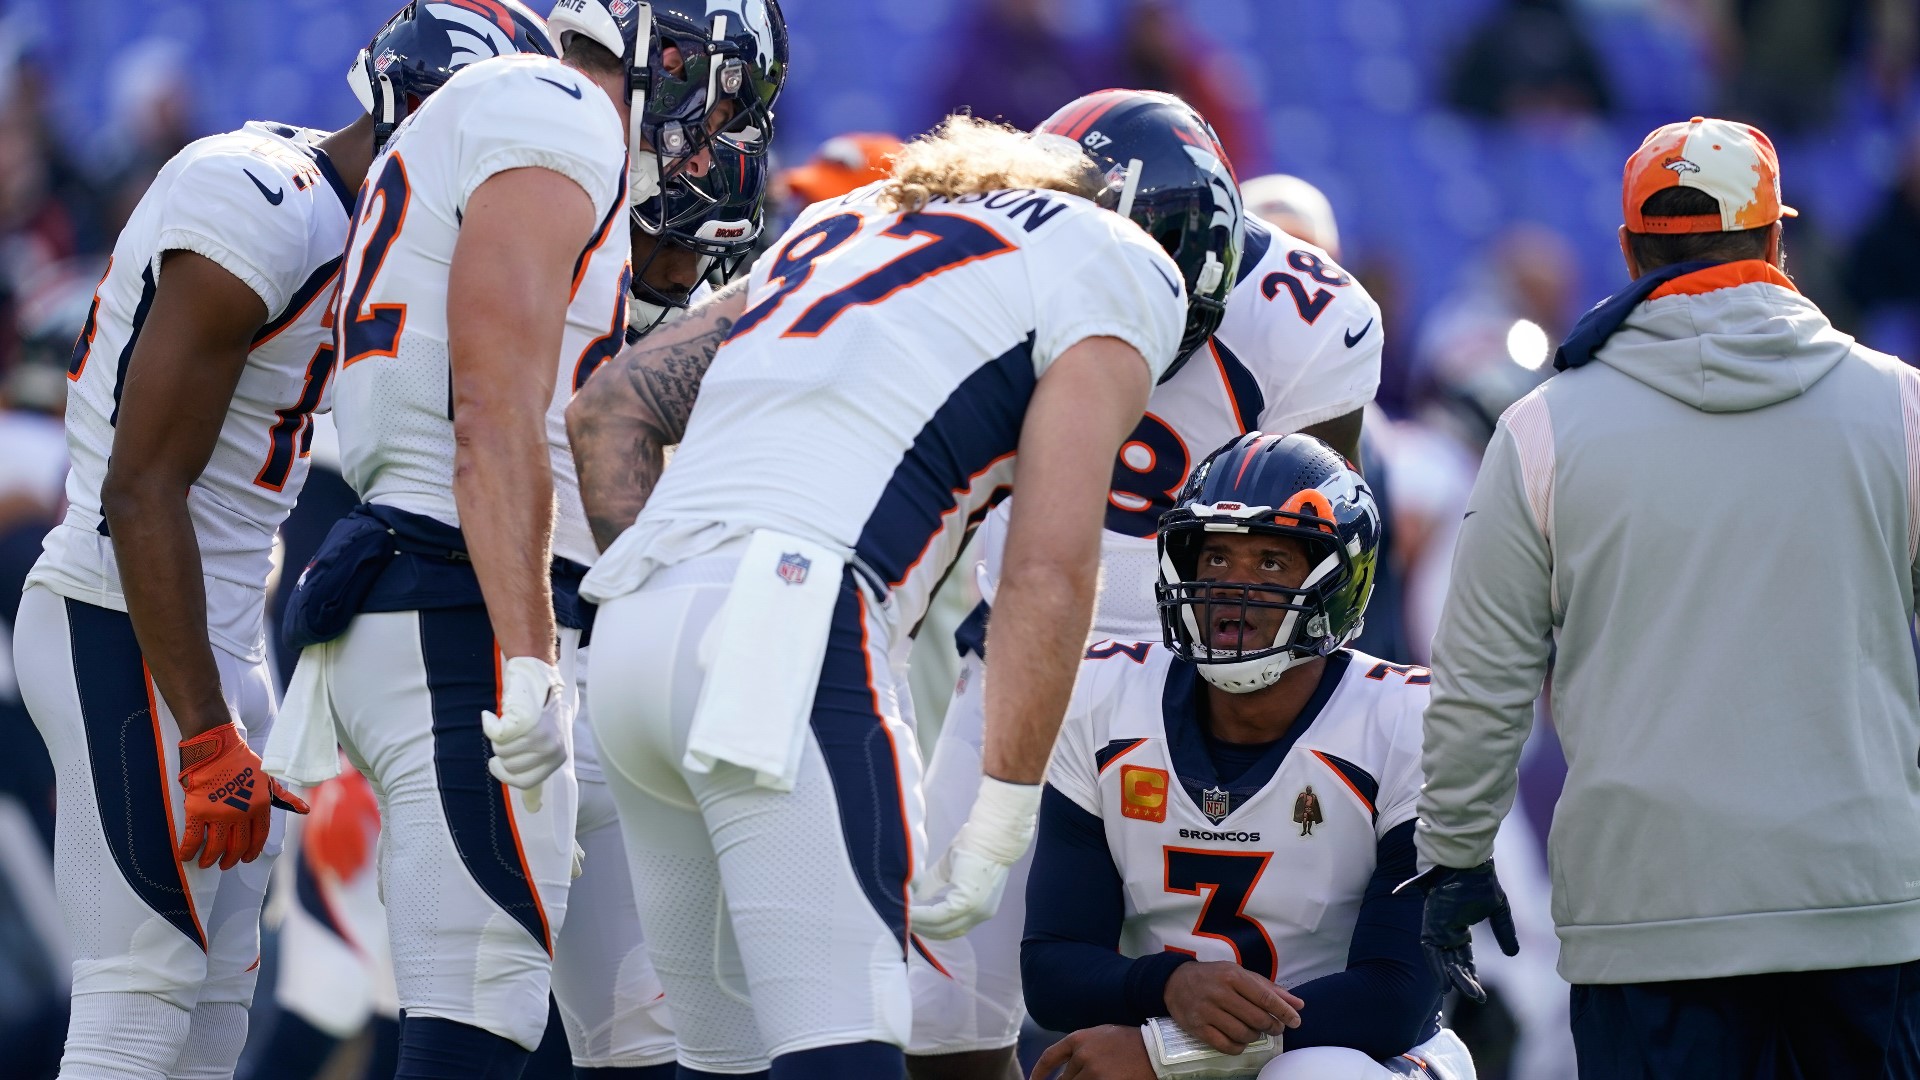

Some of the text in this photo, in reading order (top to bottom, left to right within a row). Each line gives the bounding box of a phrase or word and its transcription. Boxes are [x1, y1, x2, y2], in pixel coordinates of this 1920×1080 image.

[611, 2, 625, 15] NFL
[1084, 131, 1113, 149] 87
[715, 228, 745, 238] BRONCOS
[719, 211, 1021, 347] 87
[1260, 249, 1351, 326] 28
[1216, 503, 1241, 511] BRONCOS
[1084, 638, 1155, 665] 3
[208, 767, 253, 803] adidas
[1124, 770, 1164, 808] C
[1206, 801, 1225, 816] NFL
[1179, 829, 1260, 842] BRONCOS
[1163, 845, 1278, 983] 3
